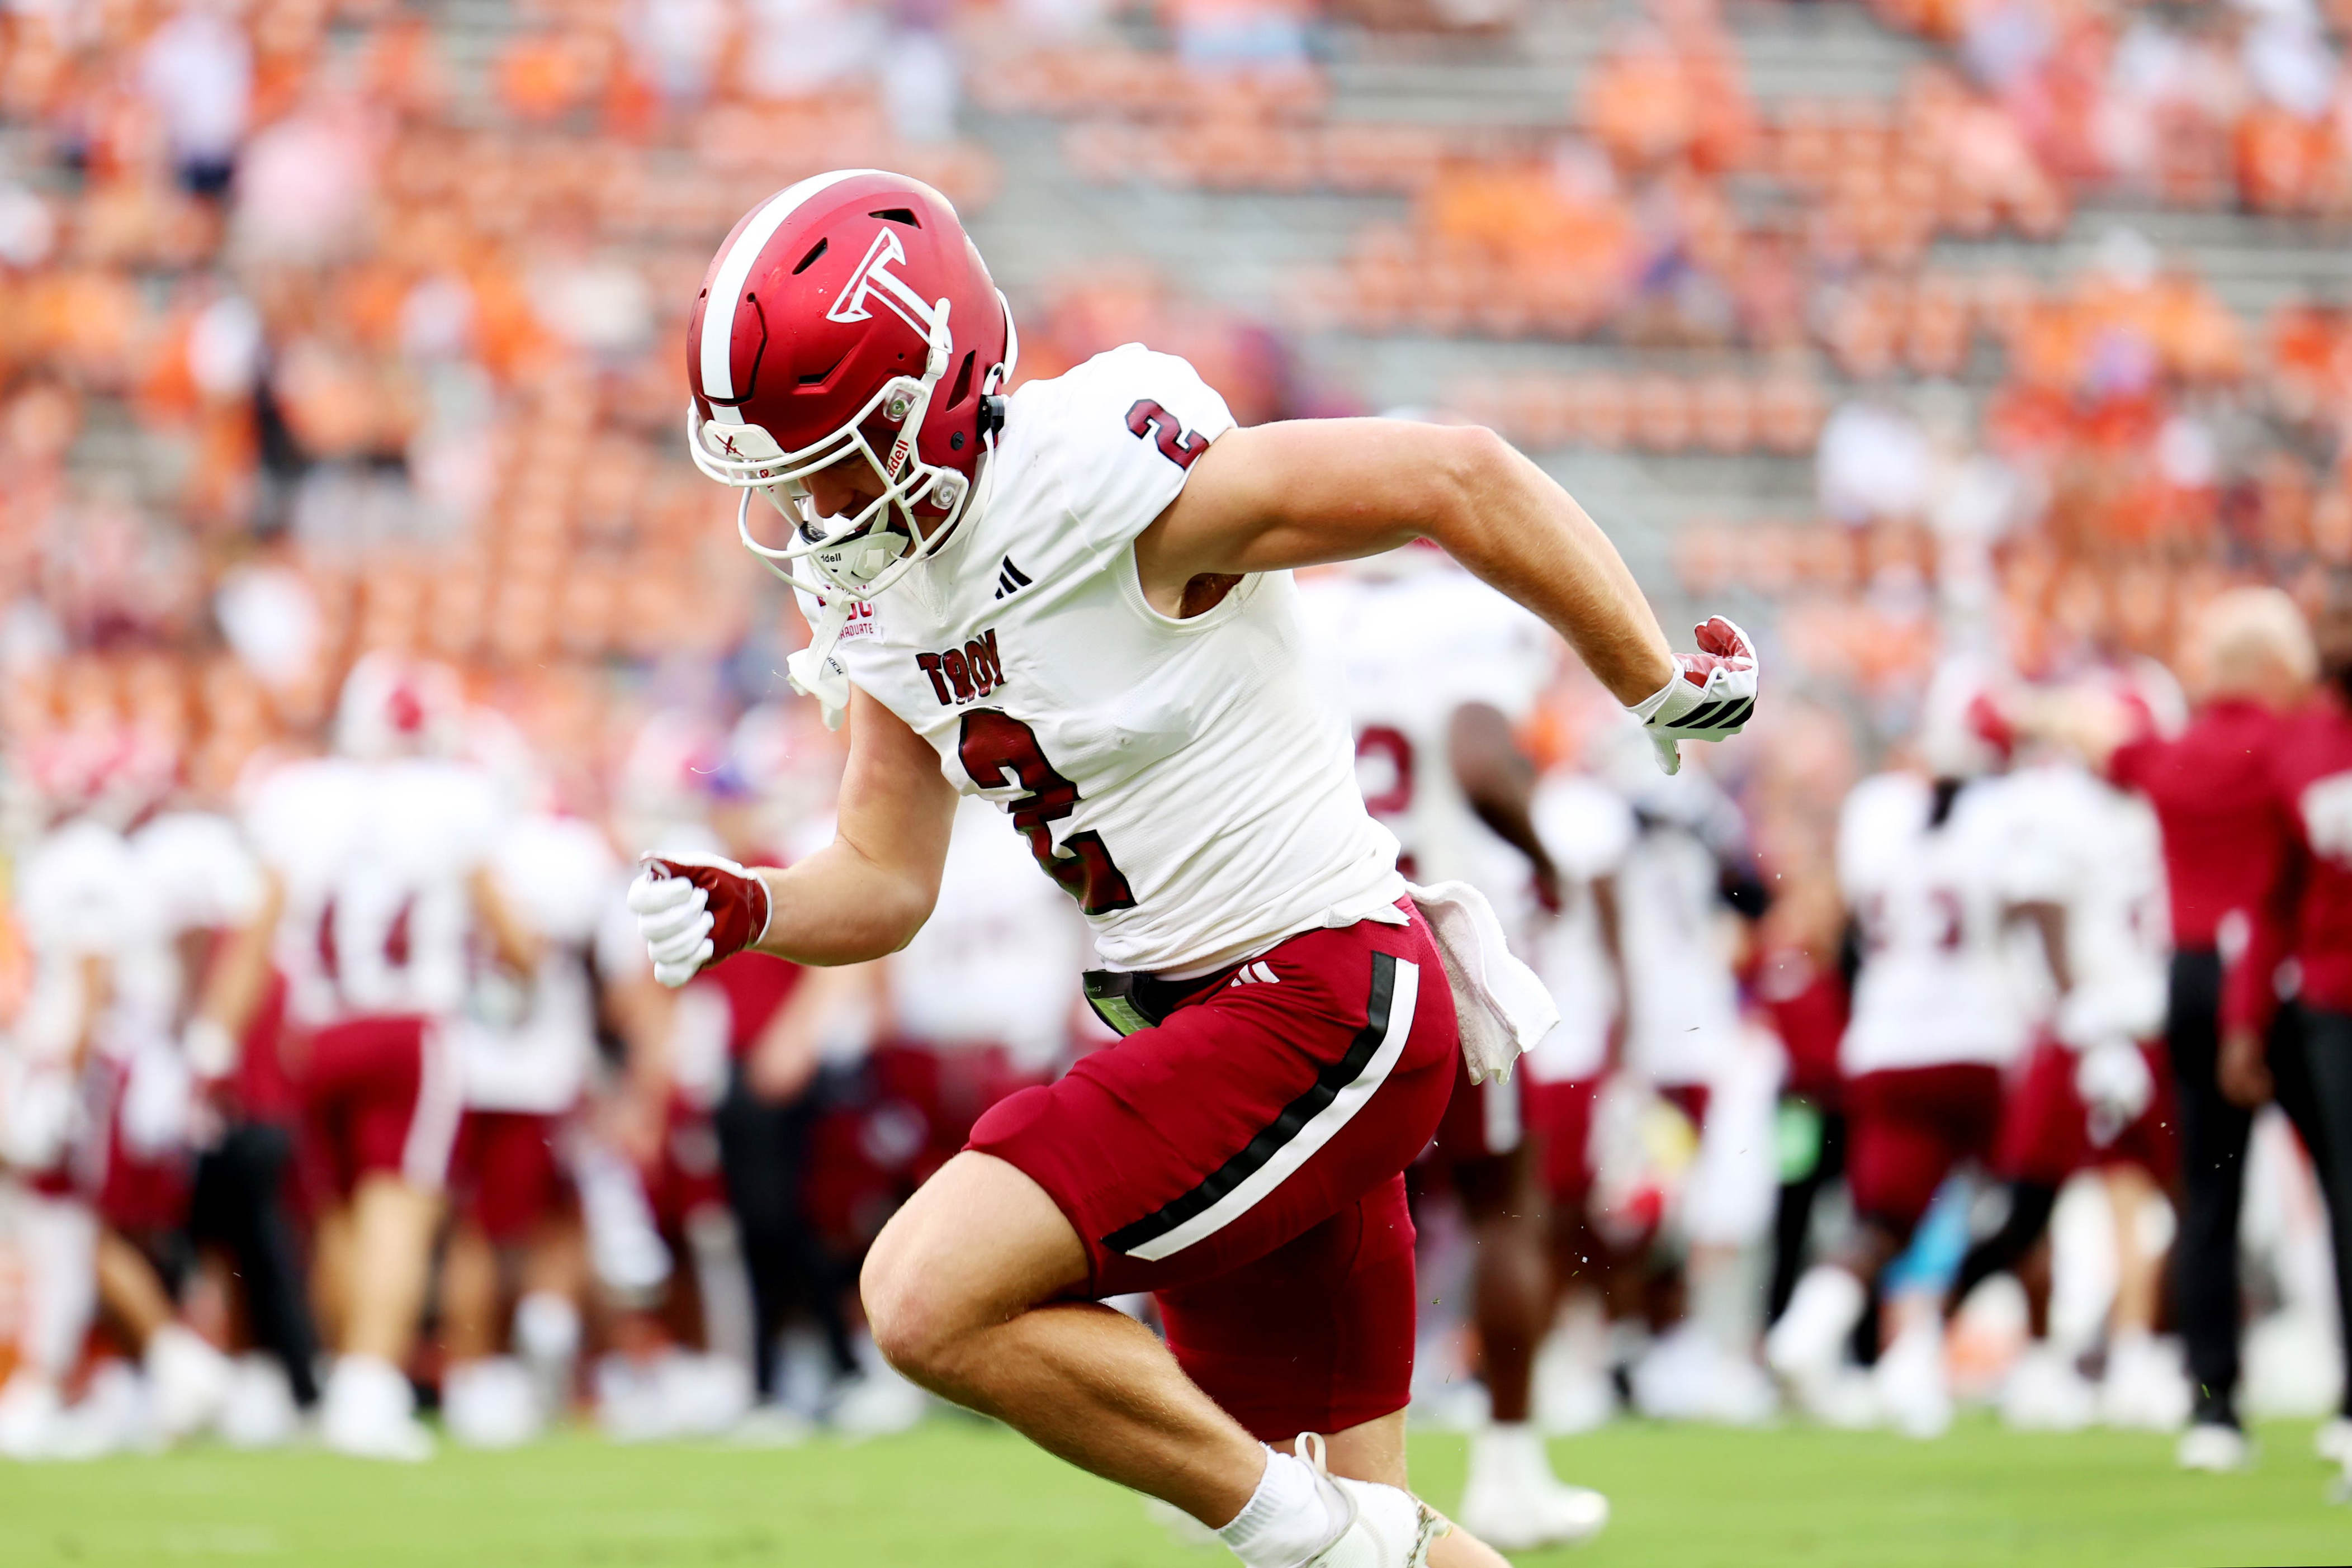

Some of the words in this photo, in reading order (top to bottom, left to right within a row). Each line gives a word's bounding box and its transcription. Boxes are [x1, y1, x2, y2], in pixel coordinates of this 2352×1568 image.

[1124, 399, 1209, 470] 2
[916, 628, 1007, 705] TROY
[959, 707, 1138, 915] 2
